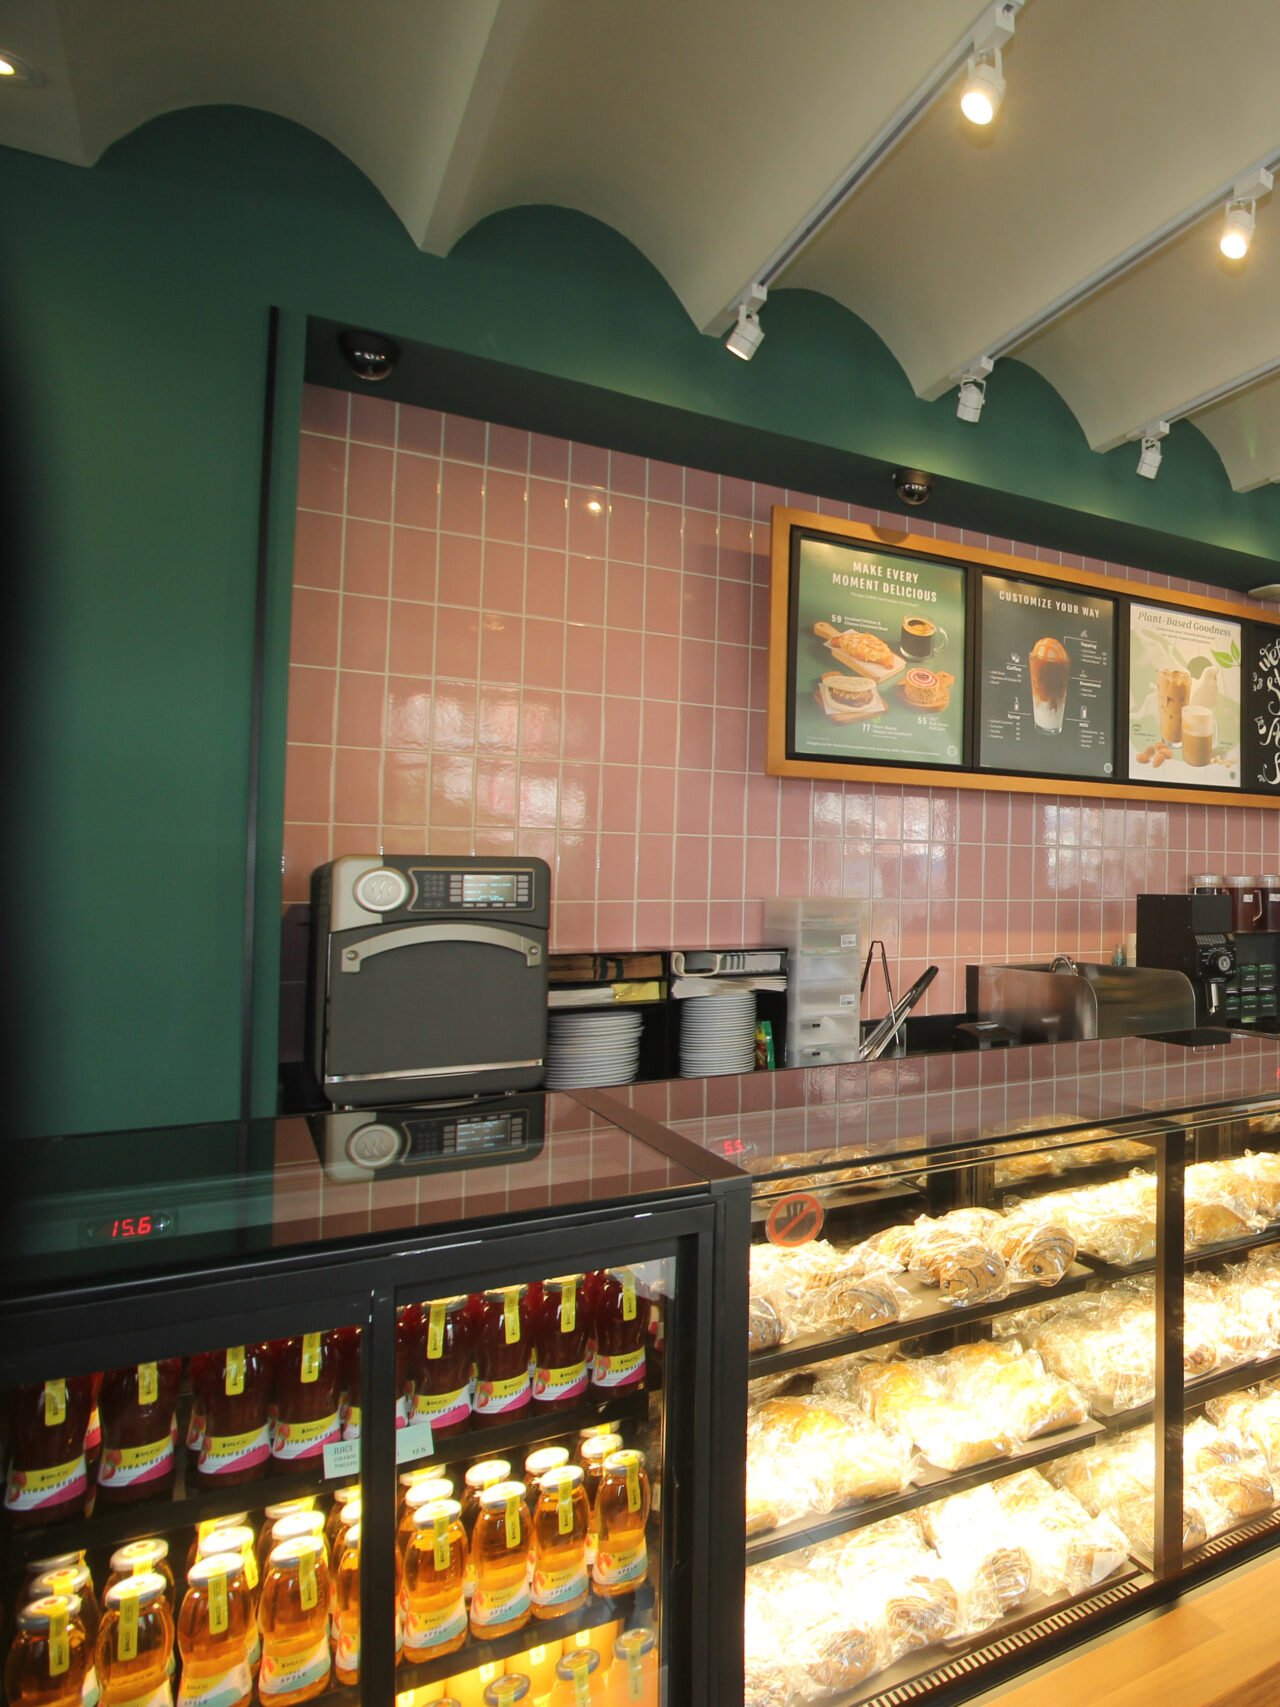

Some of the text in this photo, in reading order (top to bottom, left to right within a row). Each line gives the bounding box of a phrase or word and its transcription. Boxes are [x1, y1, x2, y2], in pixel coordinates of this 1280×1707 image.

[853, 561, 919, 584] MAKE EVERY
[832, 573, 879, 592] MOMENT
[882, 582, 937, 603] DELICIOUS
[999, 590, 1100, 619] CUSTOMIZE YOUR WAY
[831, 614, 842, 623] 59
[1138, 611, 1192, 630] Plant-Based
[1193, 622, 1231, 637] Goodness
[917, 716, 927, 725] 55
[334, 1444, 353, 1455] JUICE
[281, 1672, 306, 1683] APPLE
